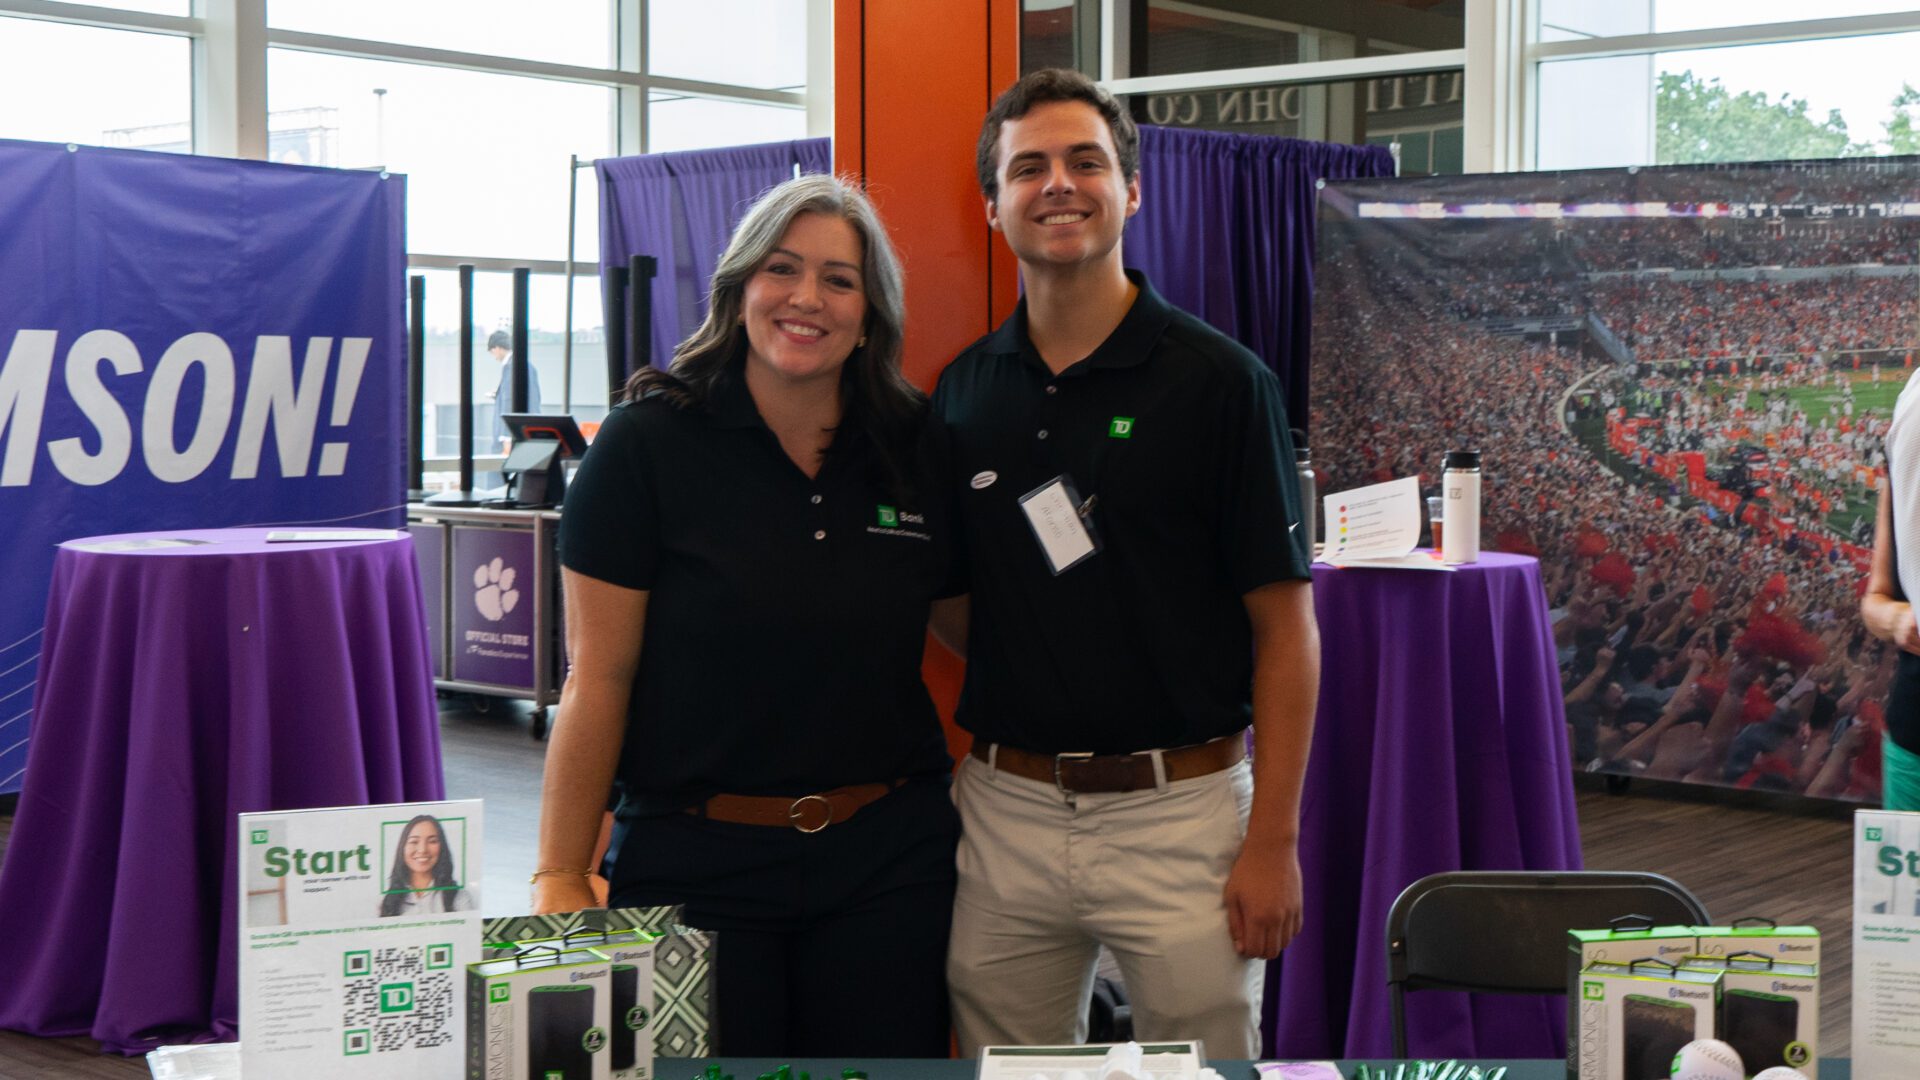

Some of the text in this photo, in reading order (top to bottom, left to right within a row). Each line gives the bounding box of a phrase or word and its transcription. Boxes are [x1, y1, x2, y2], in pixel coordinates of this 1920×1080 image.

[1112, 418, 1132, 435] TD
[877, 507, 897, 524] TD
[465, 630, 529, 646] OFFICIAL STORE
[251, 831, 269, 843] TD
[263, 844, 371, 878] Start
[381, 986, 412, 1008] TD
